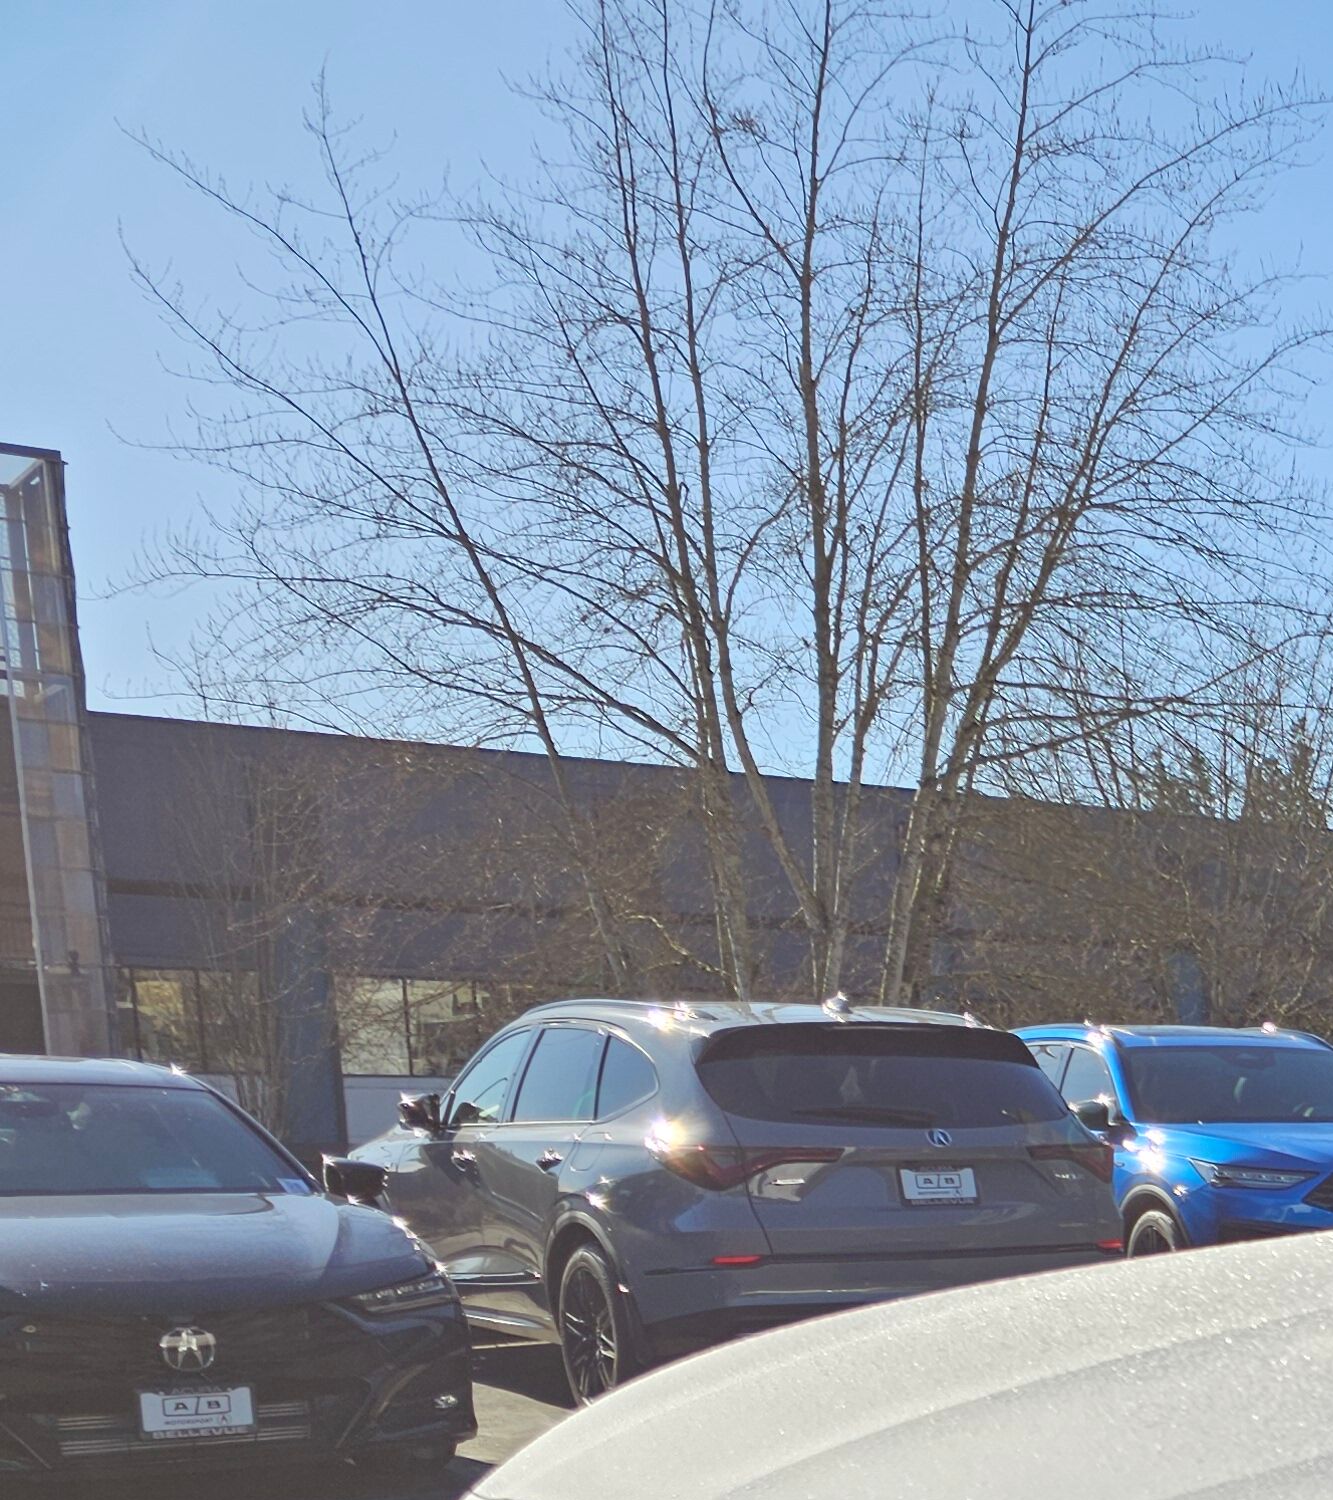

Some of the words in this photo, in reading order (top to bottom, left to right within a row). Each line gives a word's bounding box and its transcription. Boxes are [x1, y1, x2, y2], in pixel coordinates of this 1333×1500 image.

[174, 1402, 188, 1411] A
[207, 1400, 221, 1410] B
[152, 1426, 250, 1440] BELLEVUE
